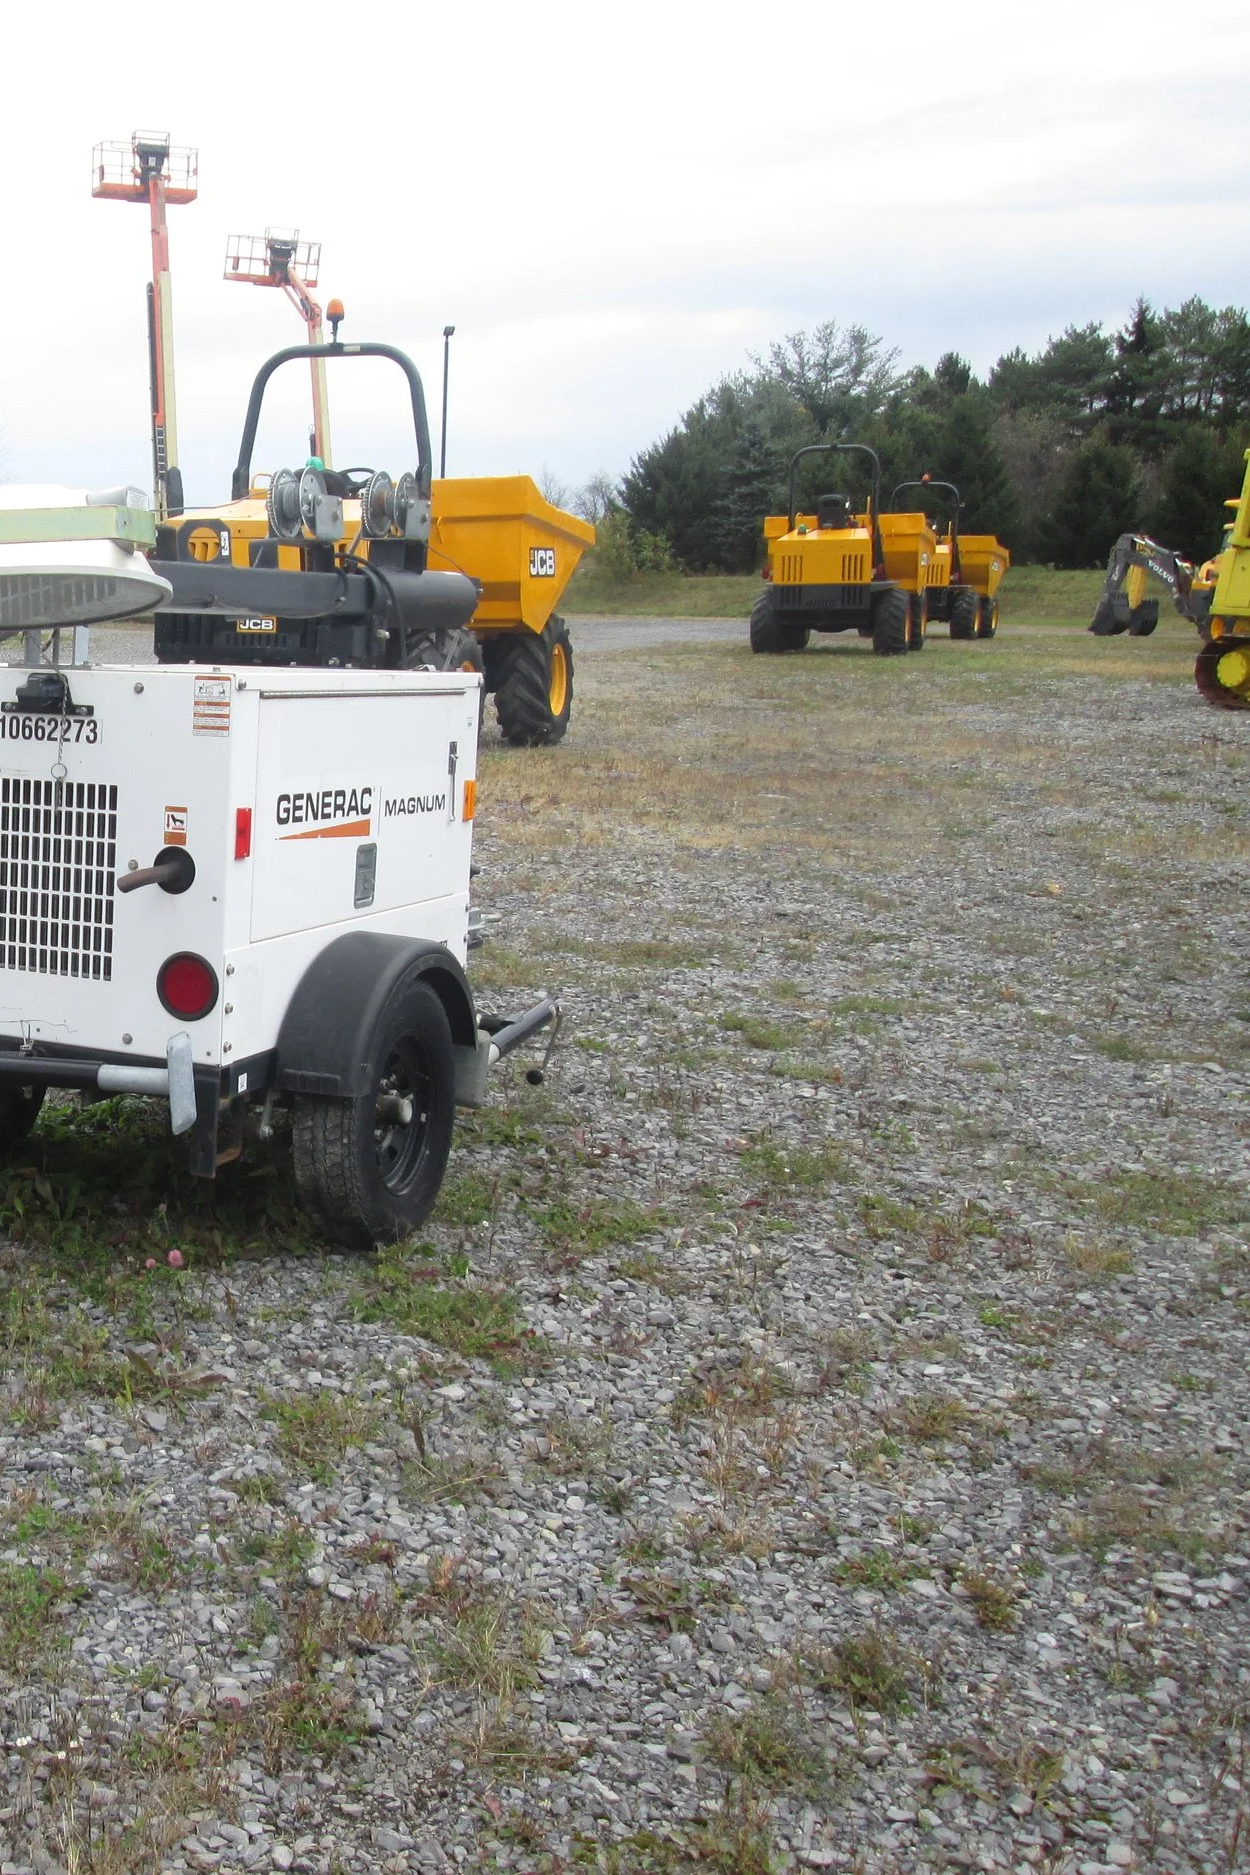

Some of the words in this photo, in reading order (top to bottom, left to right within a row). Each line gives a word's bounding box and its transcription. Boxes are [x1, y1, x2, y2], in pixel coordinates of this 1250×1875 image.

[529, 549, 555, 576] JCB
[1148, 559, 1174, 583] VOLVO
[239, 618, 274, 630] JCB
[276, 786, 373, 826] GENERAC
[384, 794, 446, 818] MAGNUM
